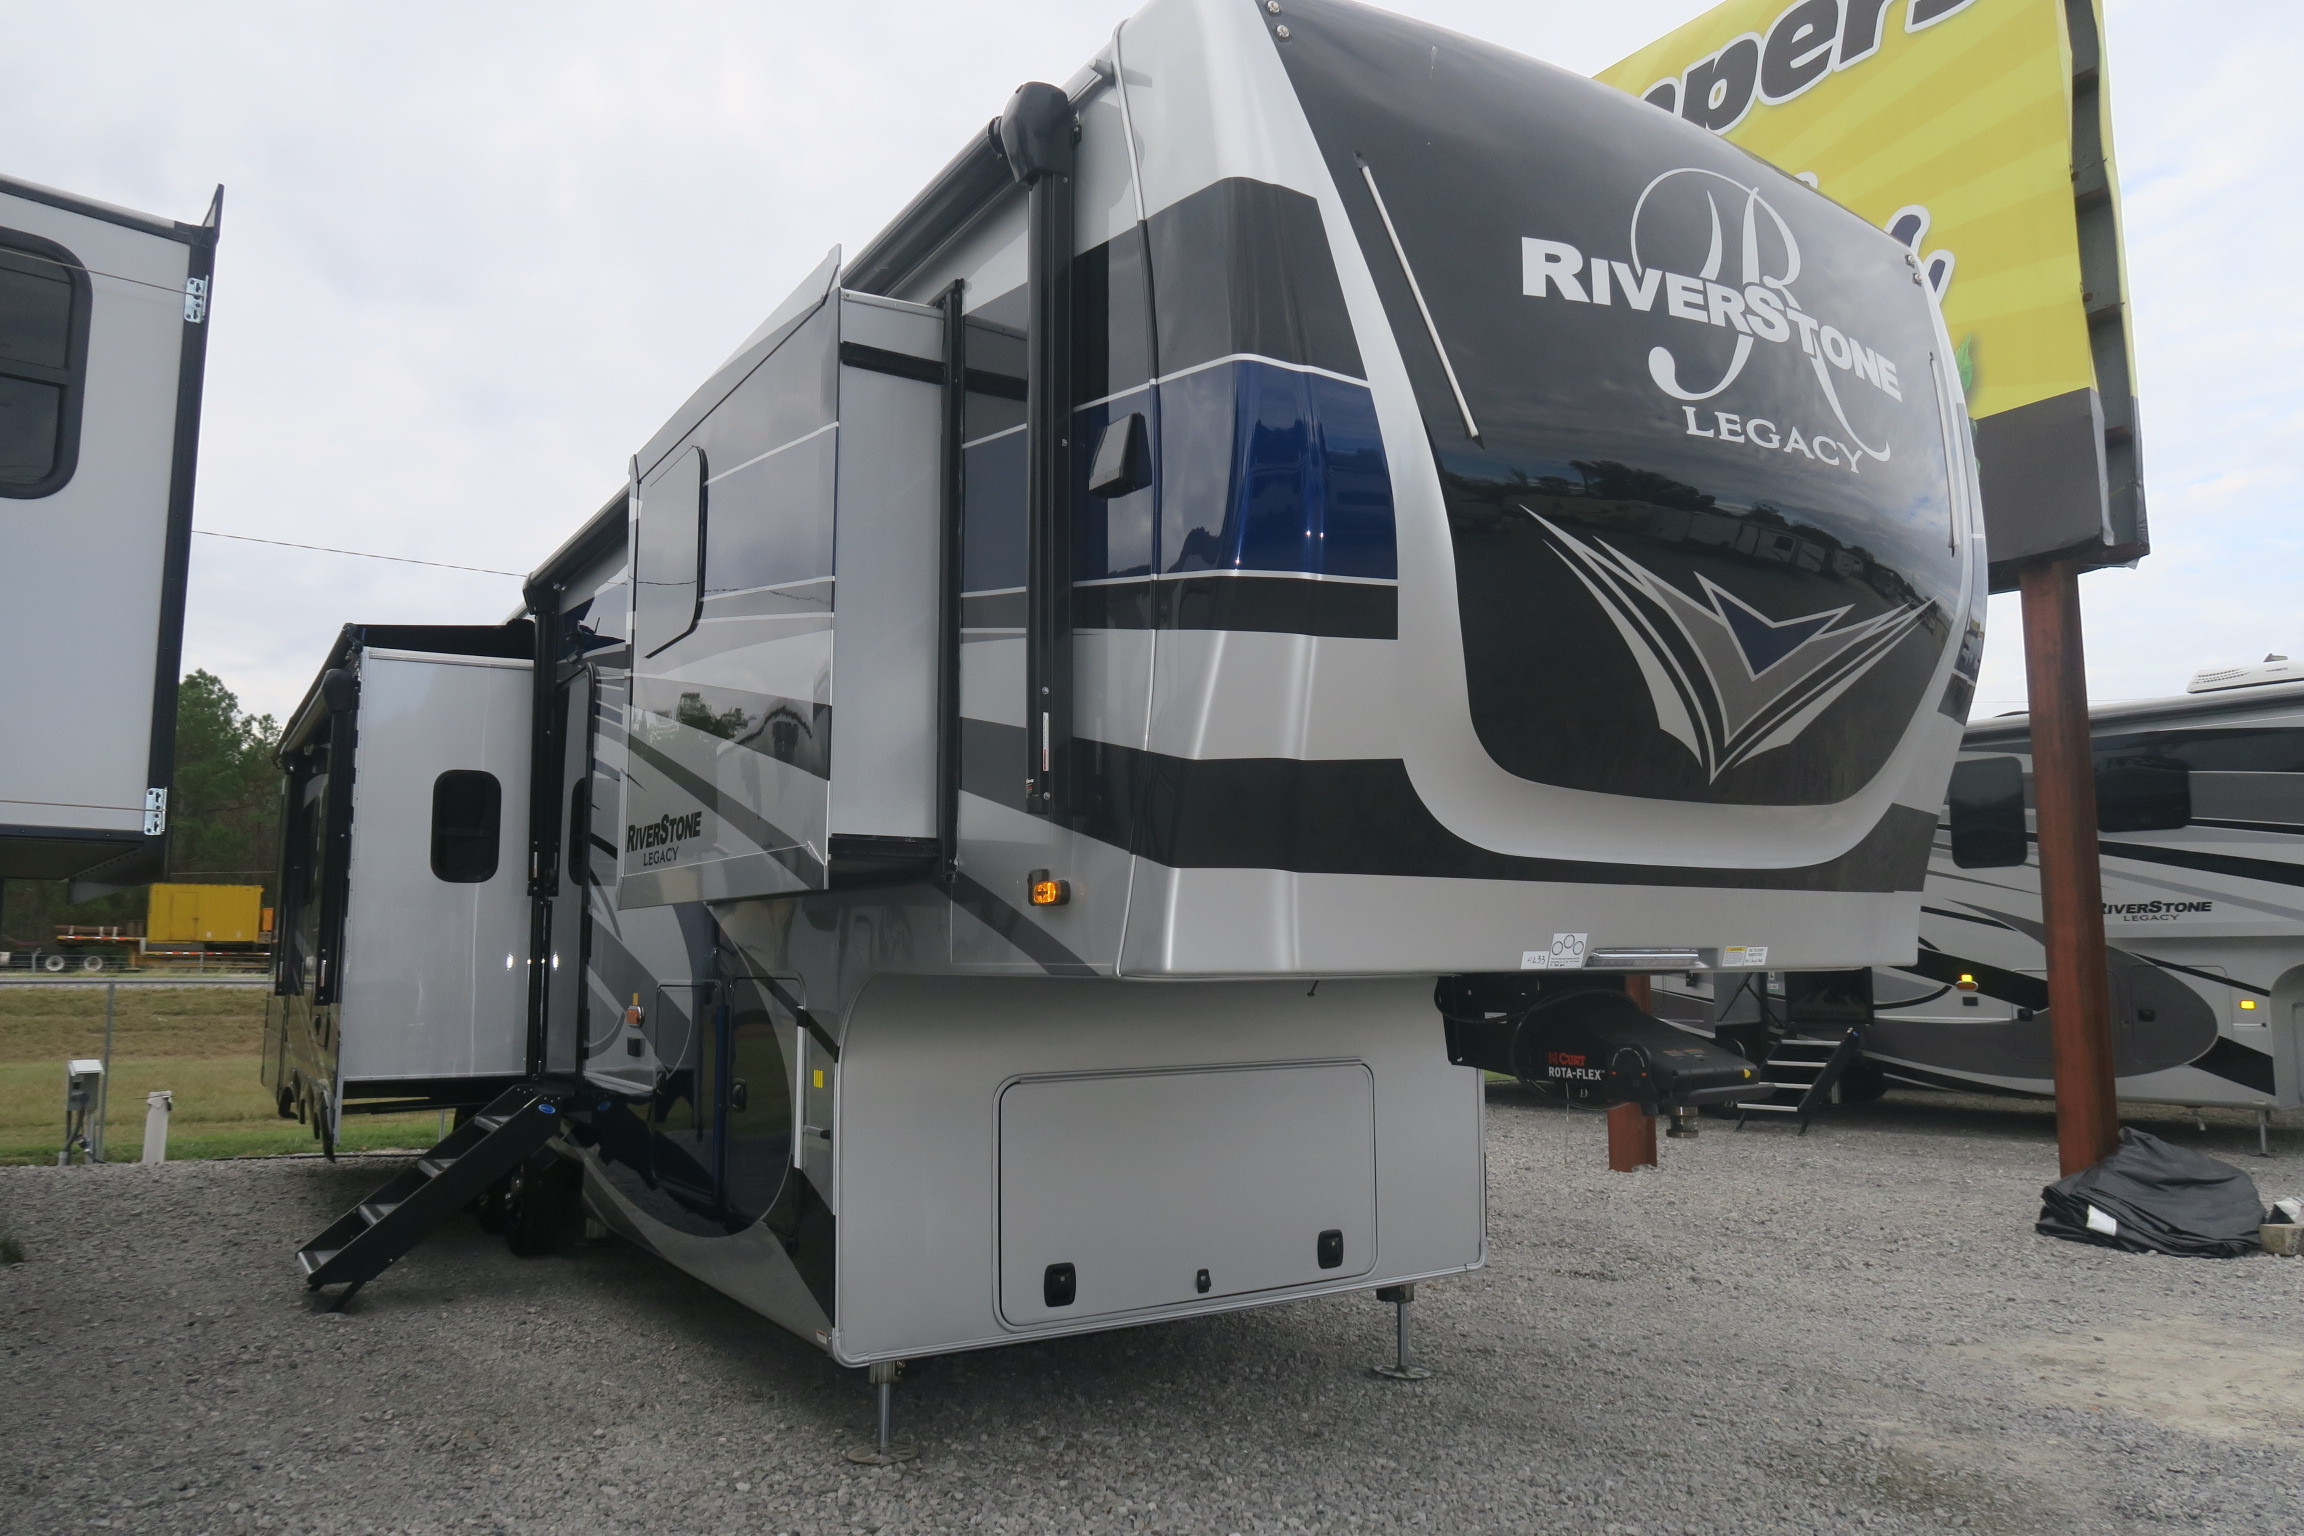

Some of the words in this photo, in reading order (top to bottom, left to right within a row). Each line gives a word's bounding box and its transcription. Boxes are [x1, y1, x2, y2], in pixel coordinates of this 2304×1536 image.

[1642, 0, 1976, 134] per
[1682, 405, 1863, 474] LEGACY
[643, 846, 679, 867] LEGACY
[2123, 913, 2180, 922] LEGACY
